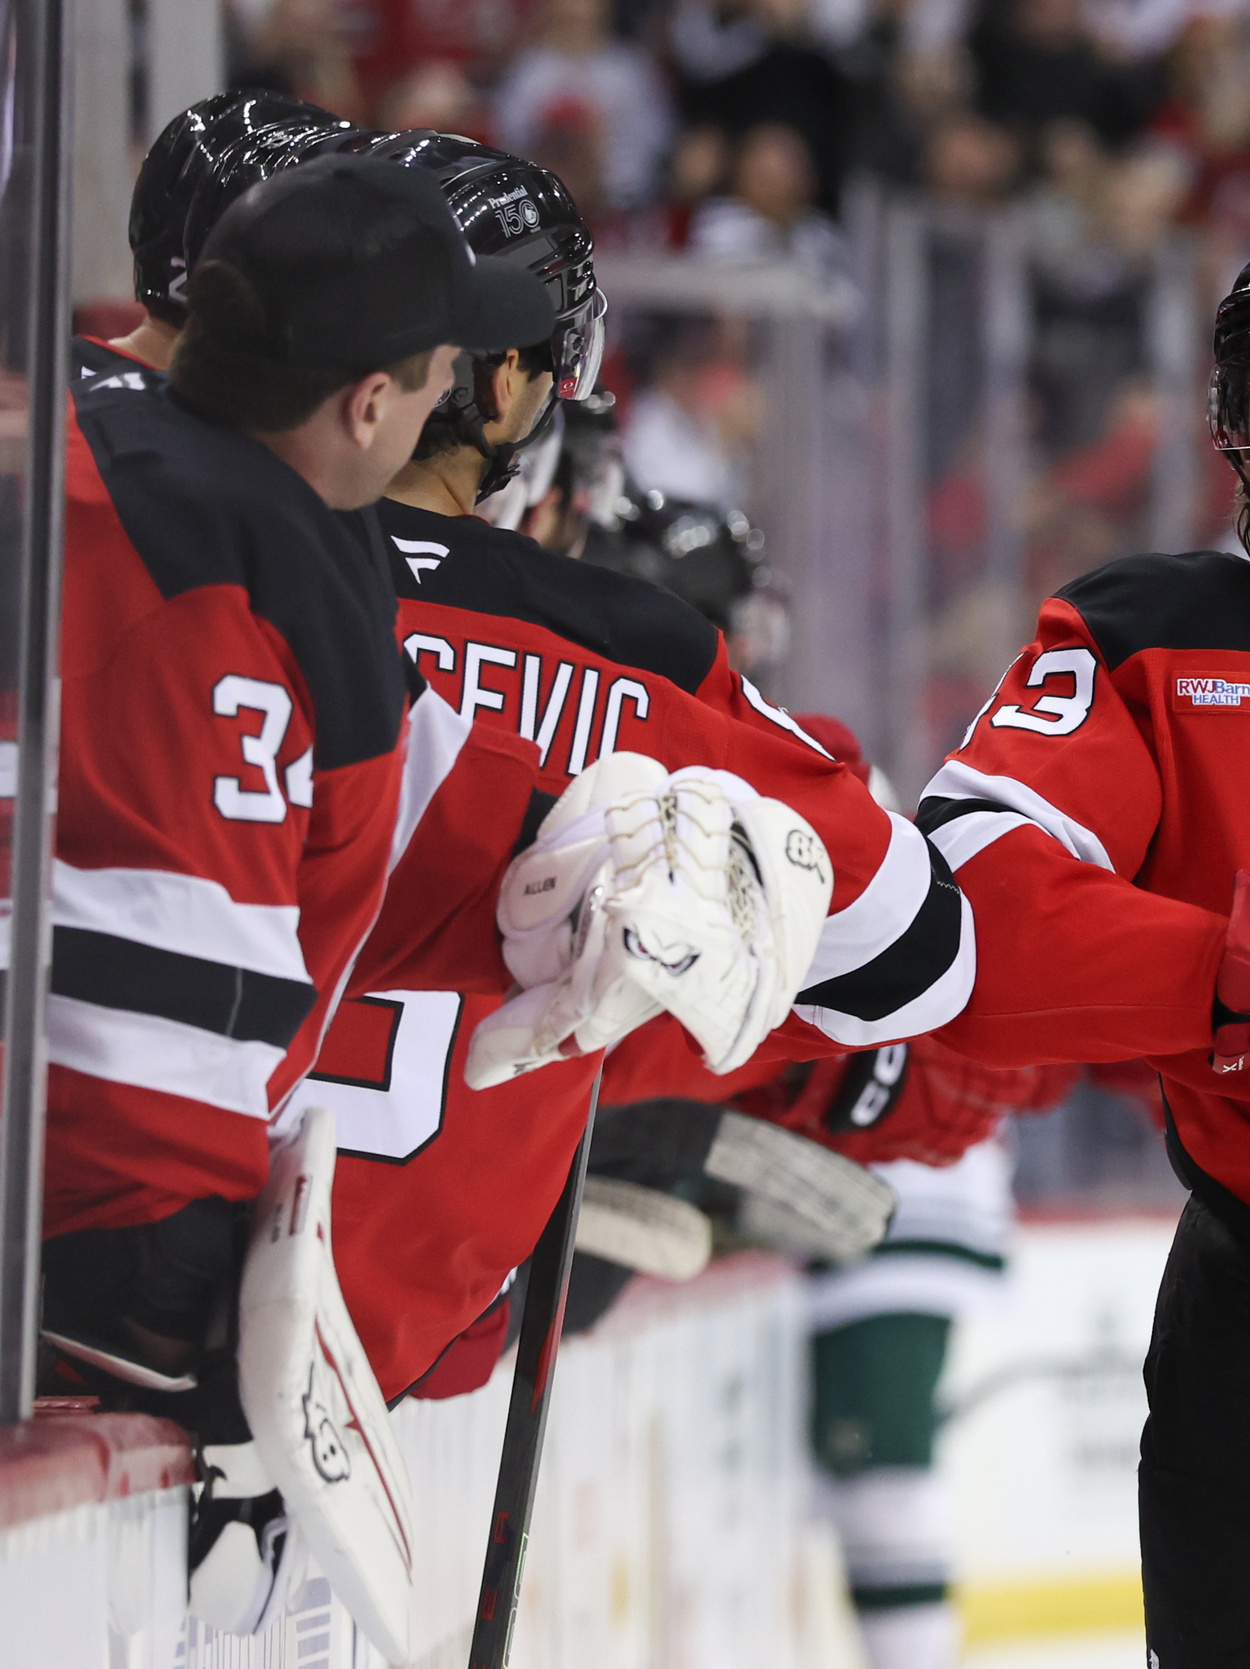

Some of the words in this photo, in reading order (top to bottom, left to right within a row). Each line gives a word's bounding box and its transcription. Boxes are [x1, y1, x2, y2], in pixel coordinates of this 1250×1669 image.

[488, 185, 528, 209] Prudential
[495, 199, 540, 238] 150
[1193, 694, 1241, 705] HEALTH
